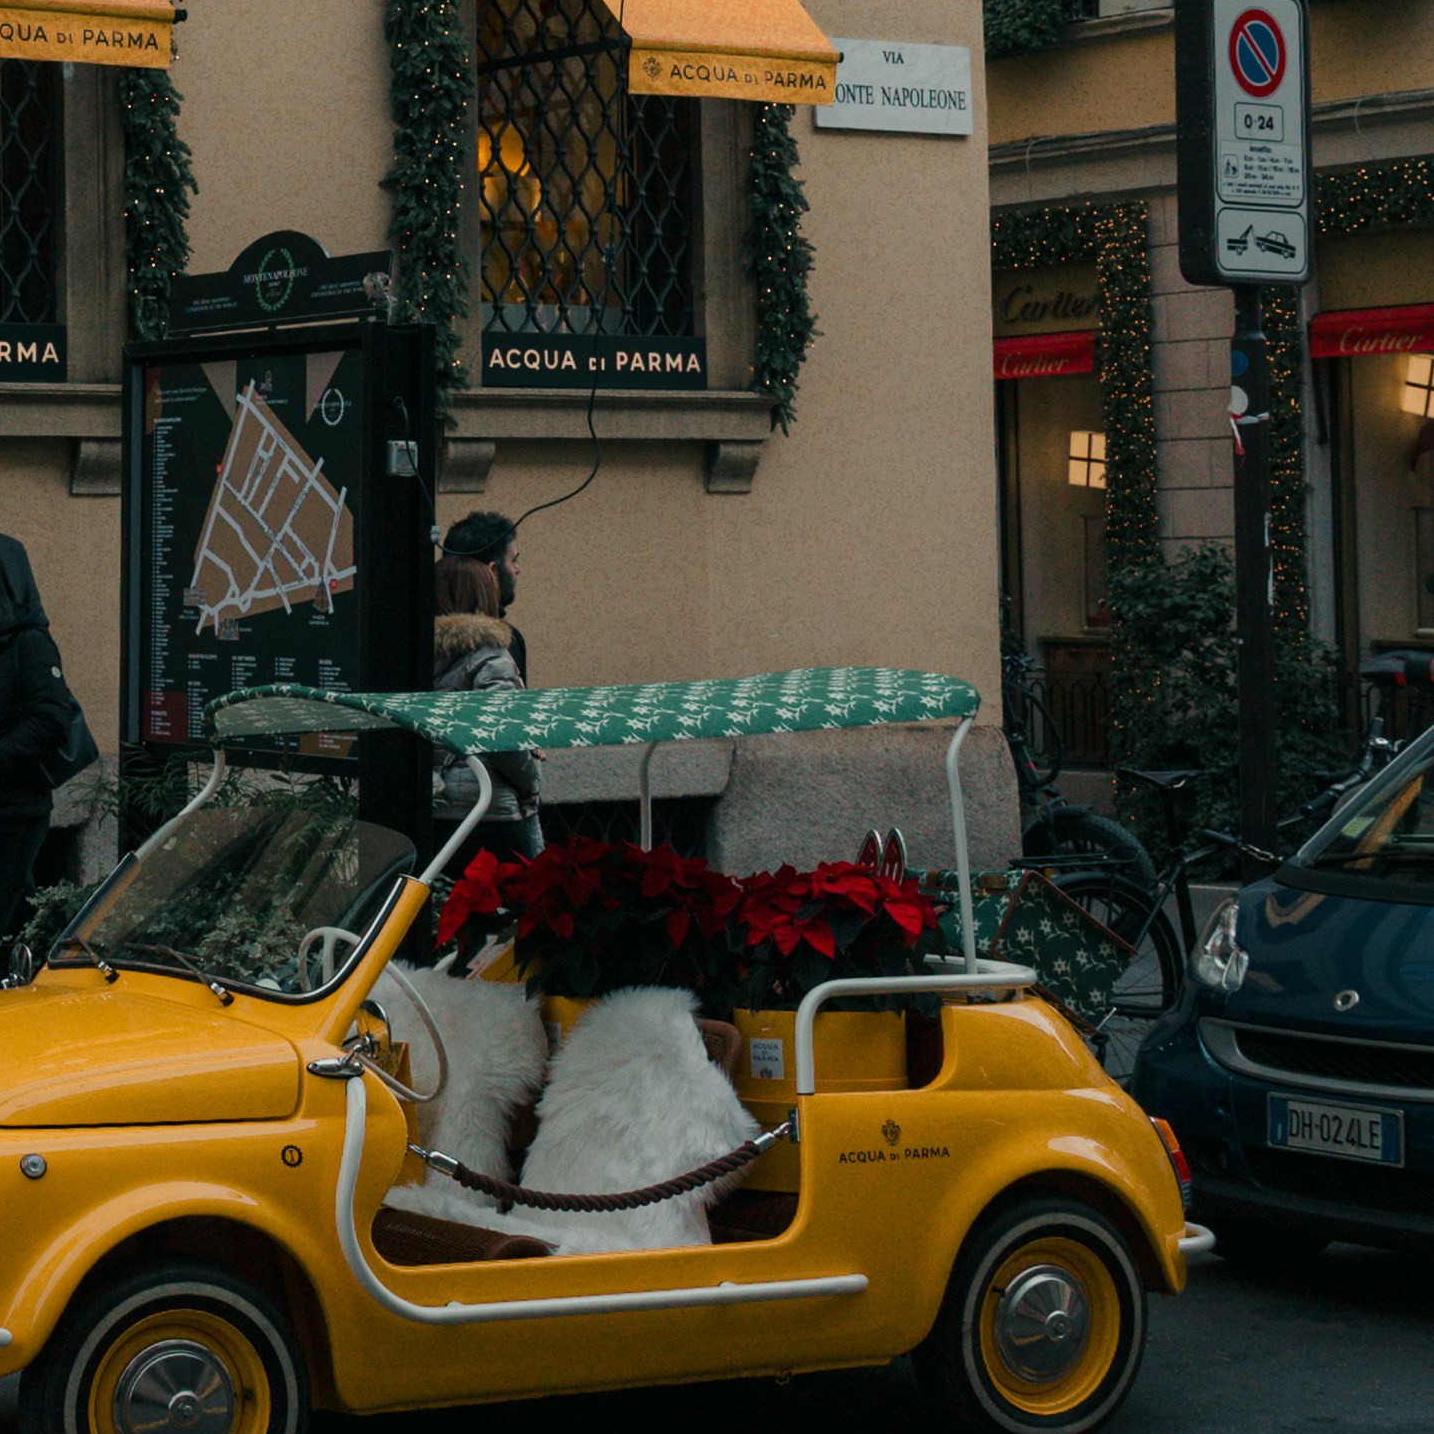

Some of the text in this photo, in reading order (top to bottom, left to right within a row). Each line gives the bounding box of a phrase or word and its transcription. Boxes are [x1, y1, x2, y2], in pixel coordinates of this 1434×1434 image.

[83, 29, 159, 51] PARMA
[882, 50, 905, 65] VIA
[670, 64, 739, 83] ACQUA
[765, 70, 827, 91] PARMA
[833, 83, 967, 111] ONTE NAPOLEONE
[1002, 284, 1097, 324] Cartier
[1339, 326, 1423, 353] Cartier
[488, 348, 578, 371] ACQUA
[615, 350, 702, 374] PARMA
[1001, 350, 1069, 376] Cartier
[839, 1150, 886, 1164] ACQUA
[904, 1146, 950, 1159] PARMA
